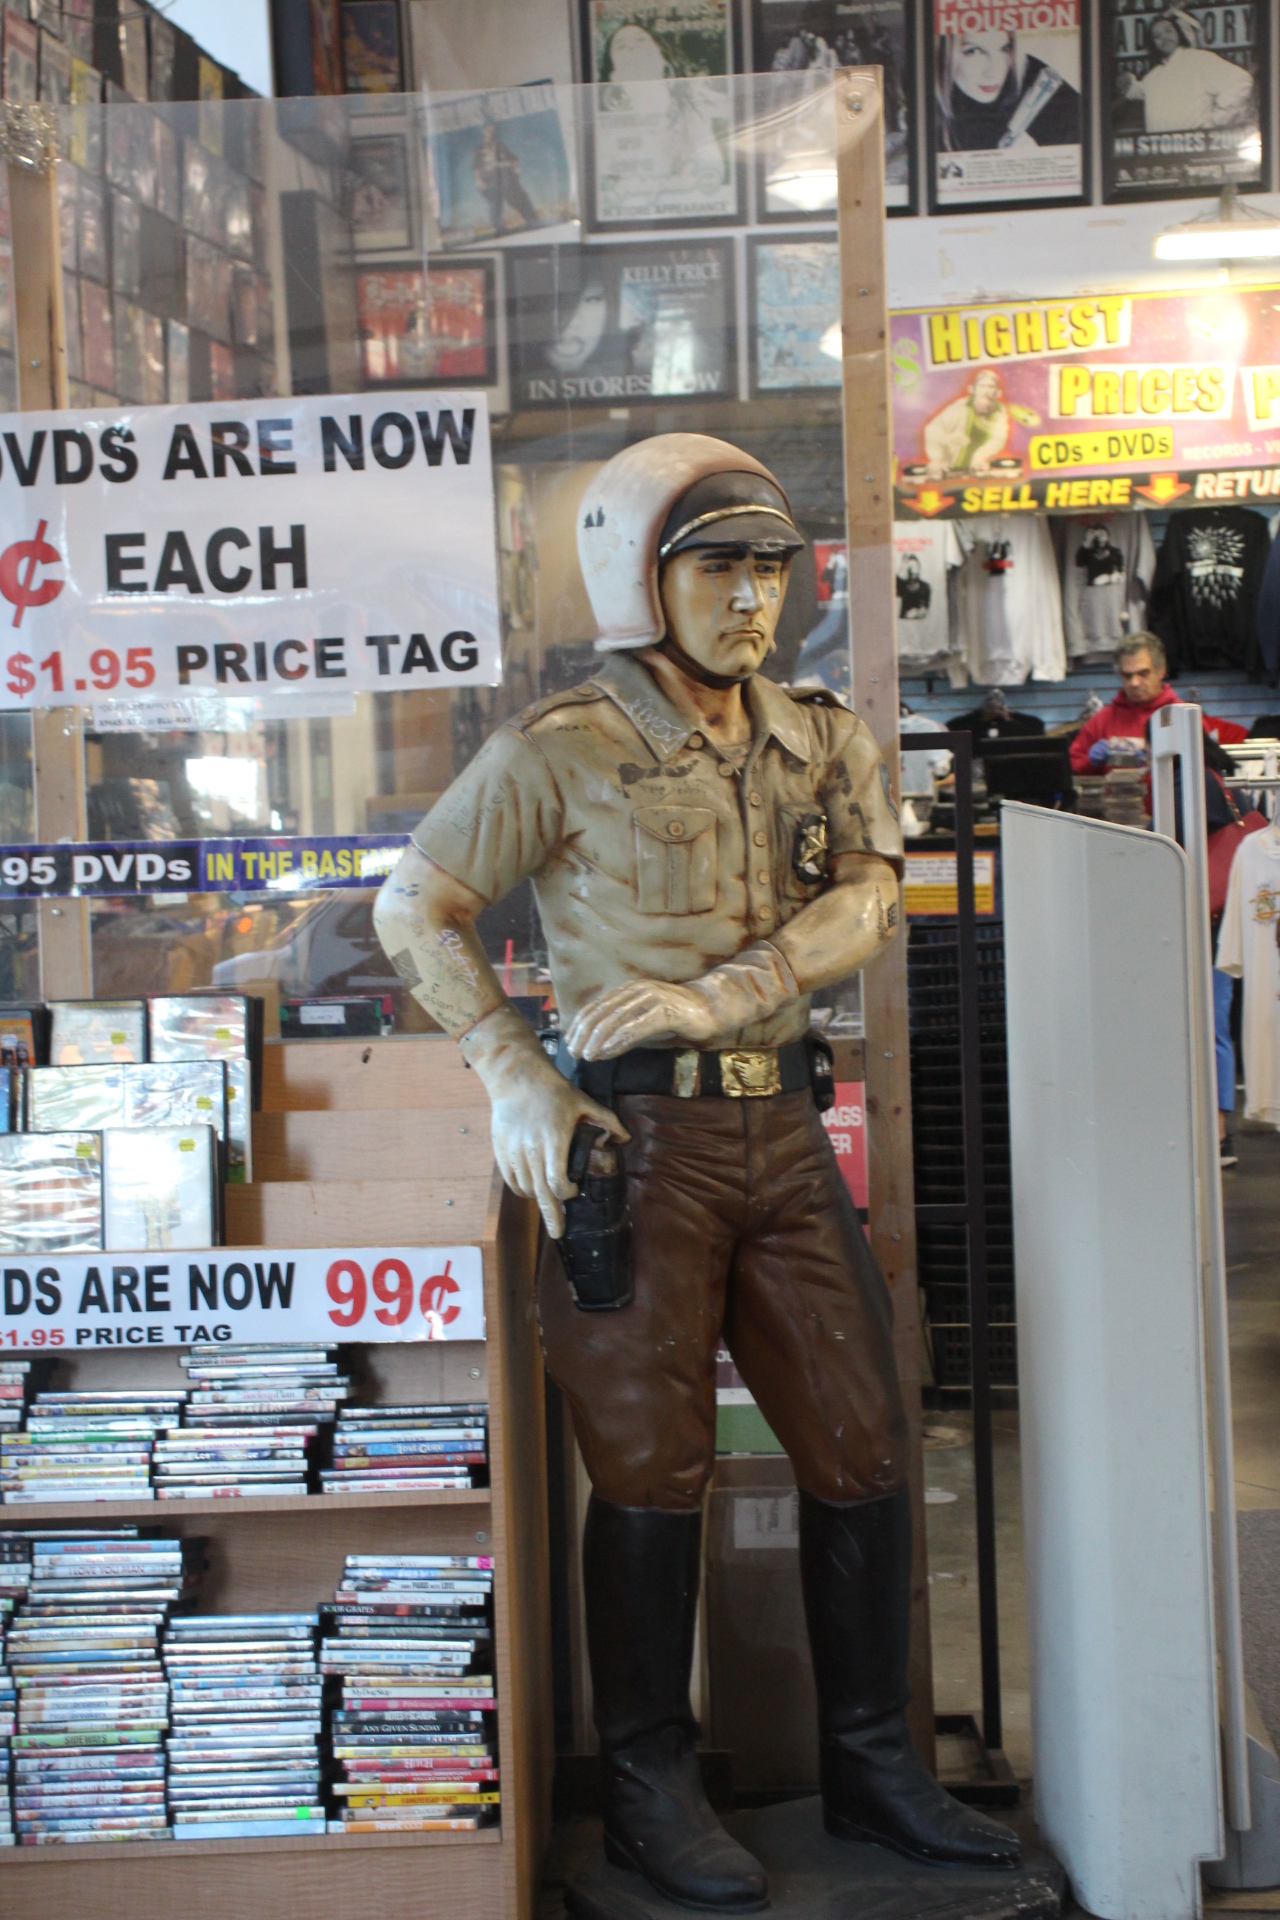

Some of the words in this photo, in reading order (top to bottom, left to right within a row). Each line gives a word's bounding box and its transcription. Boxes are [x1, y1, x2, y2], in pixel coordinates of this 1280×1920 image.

[939, 4, 1076, 35] HOUSTON
[674, 262, 722, 282] PRICE
[929, 299, 1125, 366] HIGHEST
[529, 379, 558, 399] IN
[561, 375, 652, 398] STORES
[1058, 365, 1228, 417] PRICES
[162, 417, 298, 481] ARE
[319, 408, 477, 474] NOW
[1037, 438, 1084, 466] CDs
[1107, 431, 1171, 459] DVDs
[1182, 441, 1253, 462] RECORDS
[961, 483, 1039, 513] SELL
[1044, 477, 1133, 509] HERE
[104, 523, 309, 598] EACH
[6, 645, 157, 700] $1.95
[175, 637, 349, 687] PRICE
[364, 630, 481, 677] TAG
[72, 853, 193, 885] DVDs
[206, 851, 235, 882] IN
[241, 850, 294, 880] THE
[820, 1105, 863, 1128] AGS
[78, 1265, 171, 1314] ARE
[188, 1261, 296, 1312] NOW
[325, 1257, 462, 1341] 99¢
[75, 1326, 165, 1346] PRICE
[174, 1323, 233, 1343] TAG
[213, 1487, 242, 1498] LIFE
[73, 1566, 97, 1576] LOVE
[323, 1605, 345, 1613] SOUR
[345, 1605, 375, 1613] GRAPES
[362, 1724, 380, 1733] ANY
[381, 1724, 408, 1732] GIVEN
[407, 1723, 442, 1732] SUNDAY
